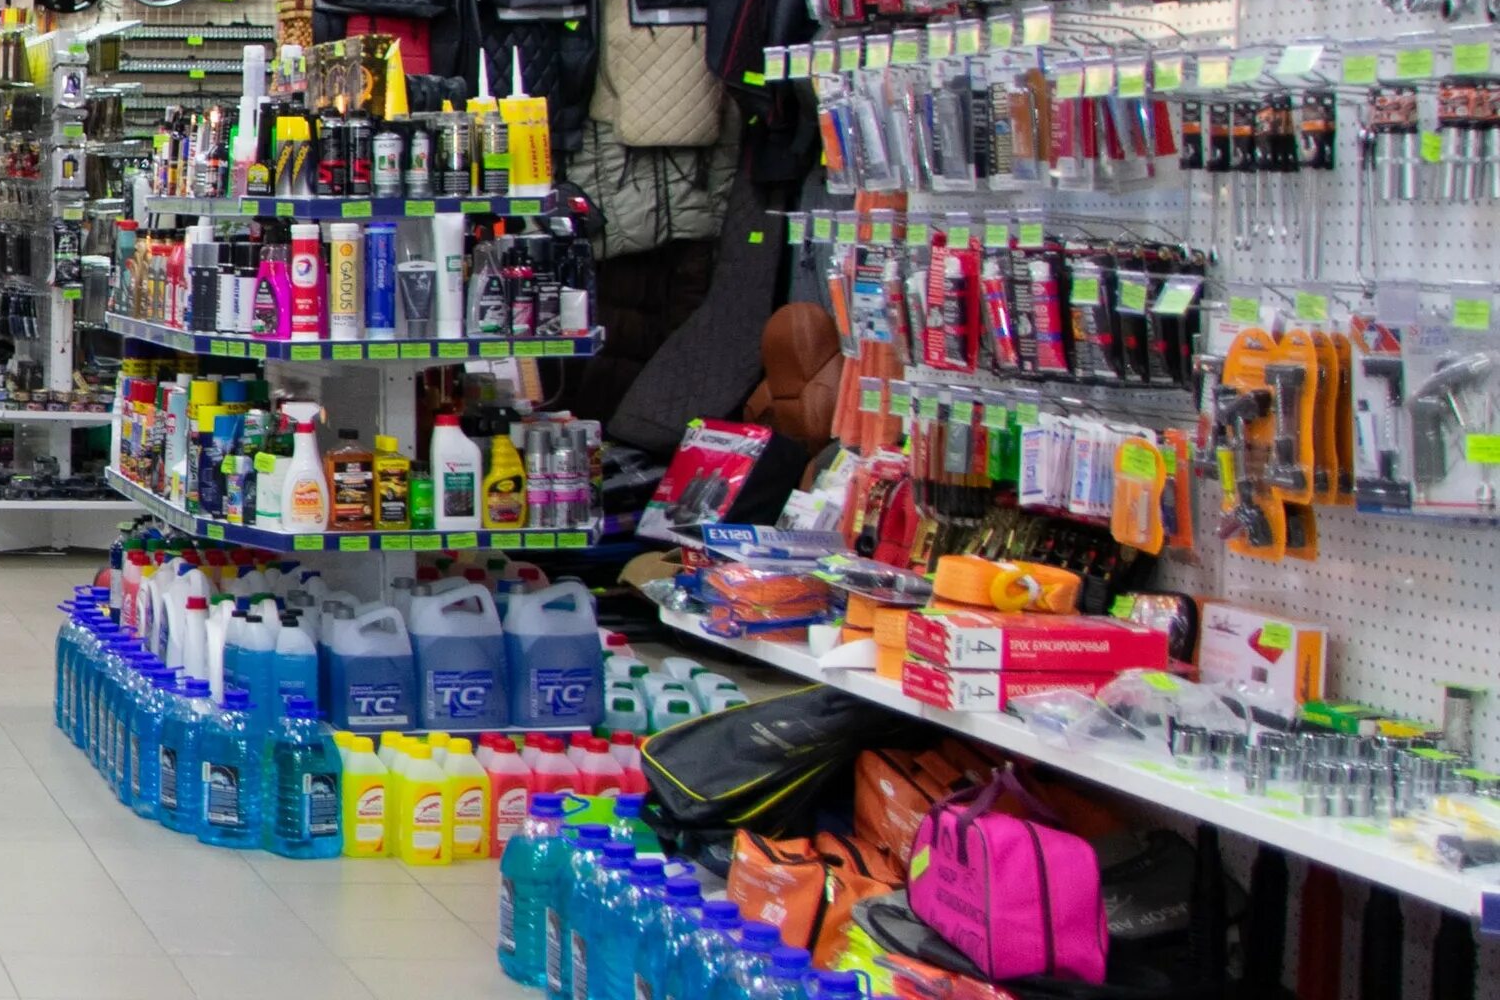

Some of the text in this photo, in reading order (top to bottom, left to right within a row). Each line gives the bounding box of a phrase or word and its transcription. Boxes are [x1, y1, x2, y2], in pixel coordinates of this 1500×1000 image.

[340, 261, 354, 310] GADUS
[708, 528, 753, 541] EX120
[970, 640, 997, 655] 4
[1008, 639, 1111, 653] ТРОС БУКСИРОВОЧНЫЙ
[970, 685, 996, 700] 4
